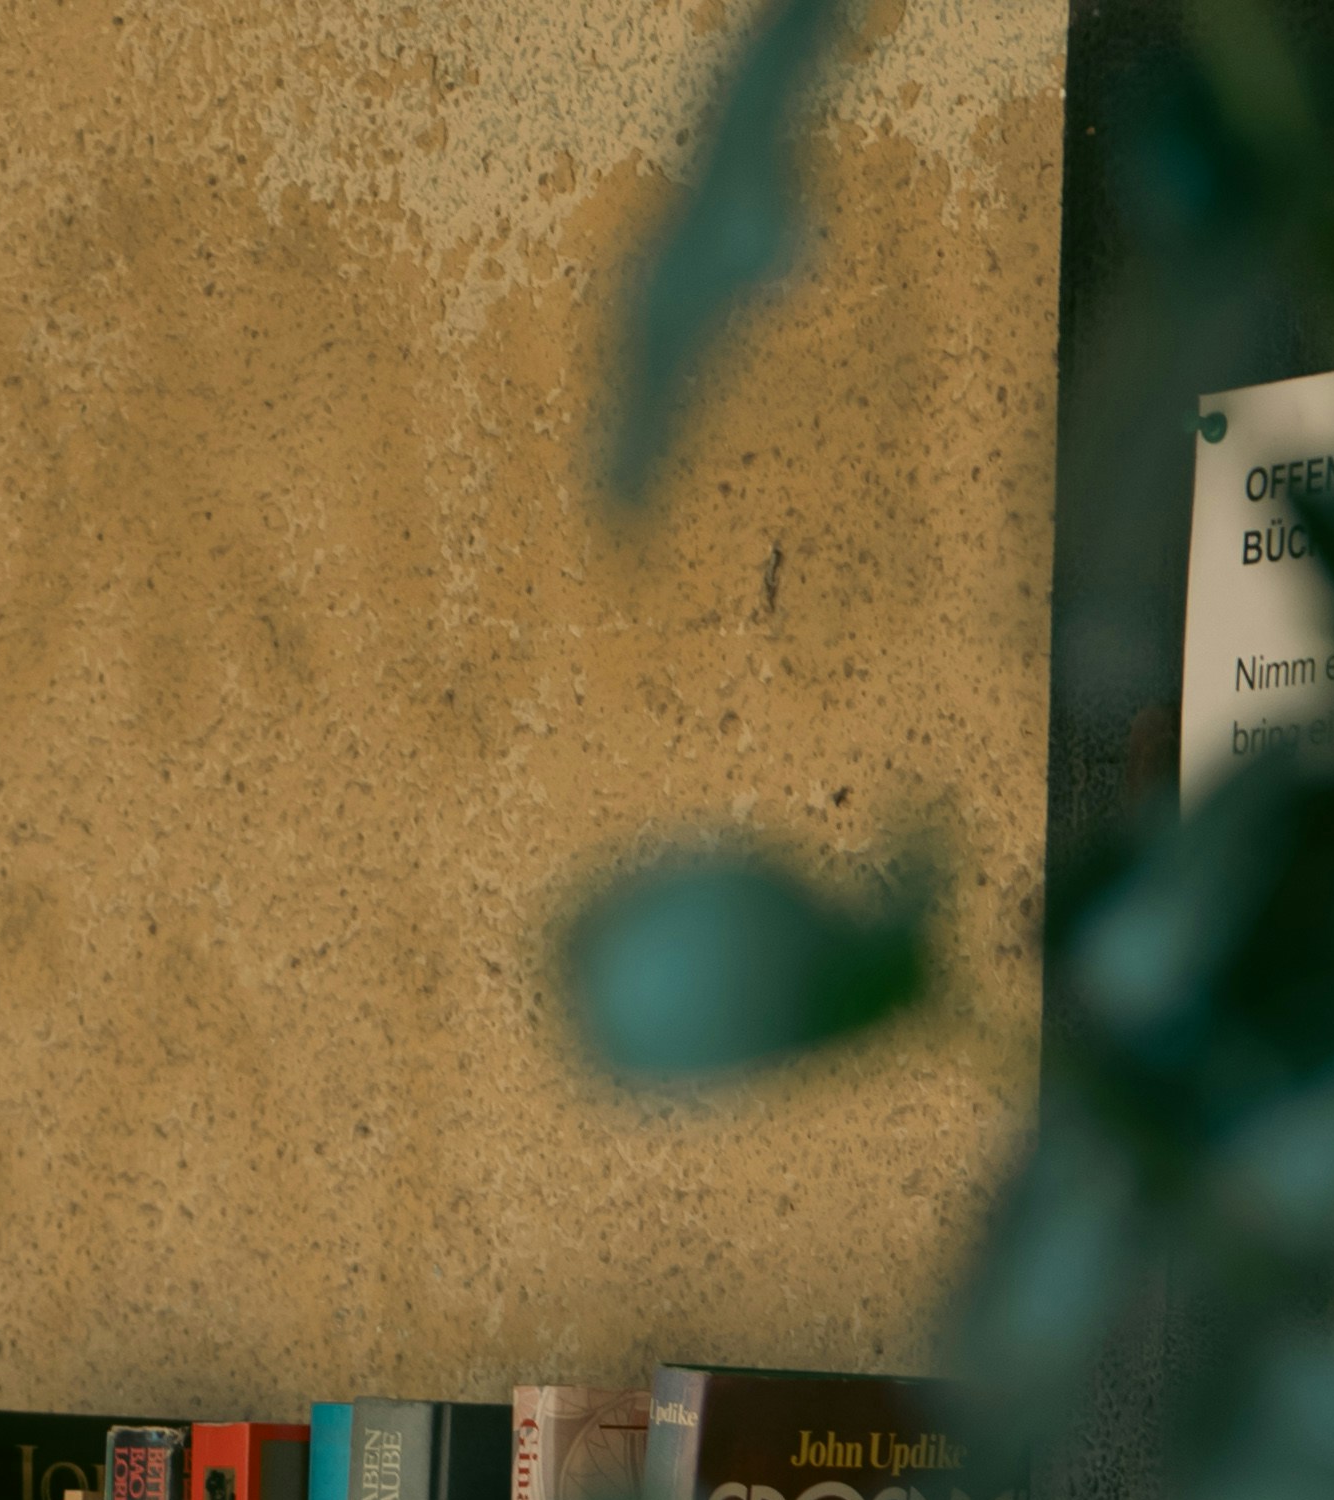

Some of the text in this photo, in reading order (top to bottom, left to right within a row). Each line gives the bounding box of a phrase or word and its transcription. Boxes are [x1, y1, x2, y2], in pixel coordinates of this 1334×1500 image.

[1235, 654, 1316, 692] Nimm
[129, 1447, 146, 1499] BAO
[790, 1430, 967, 1476] John Updike
